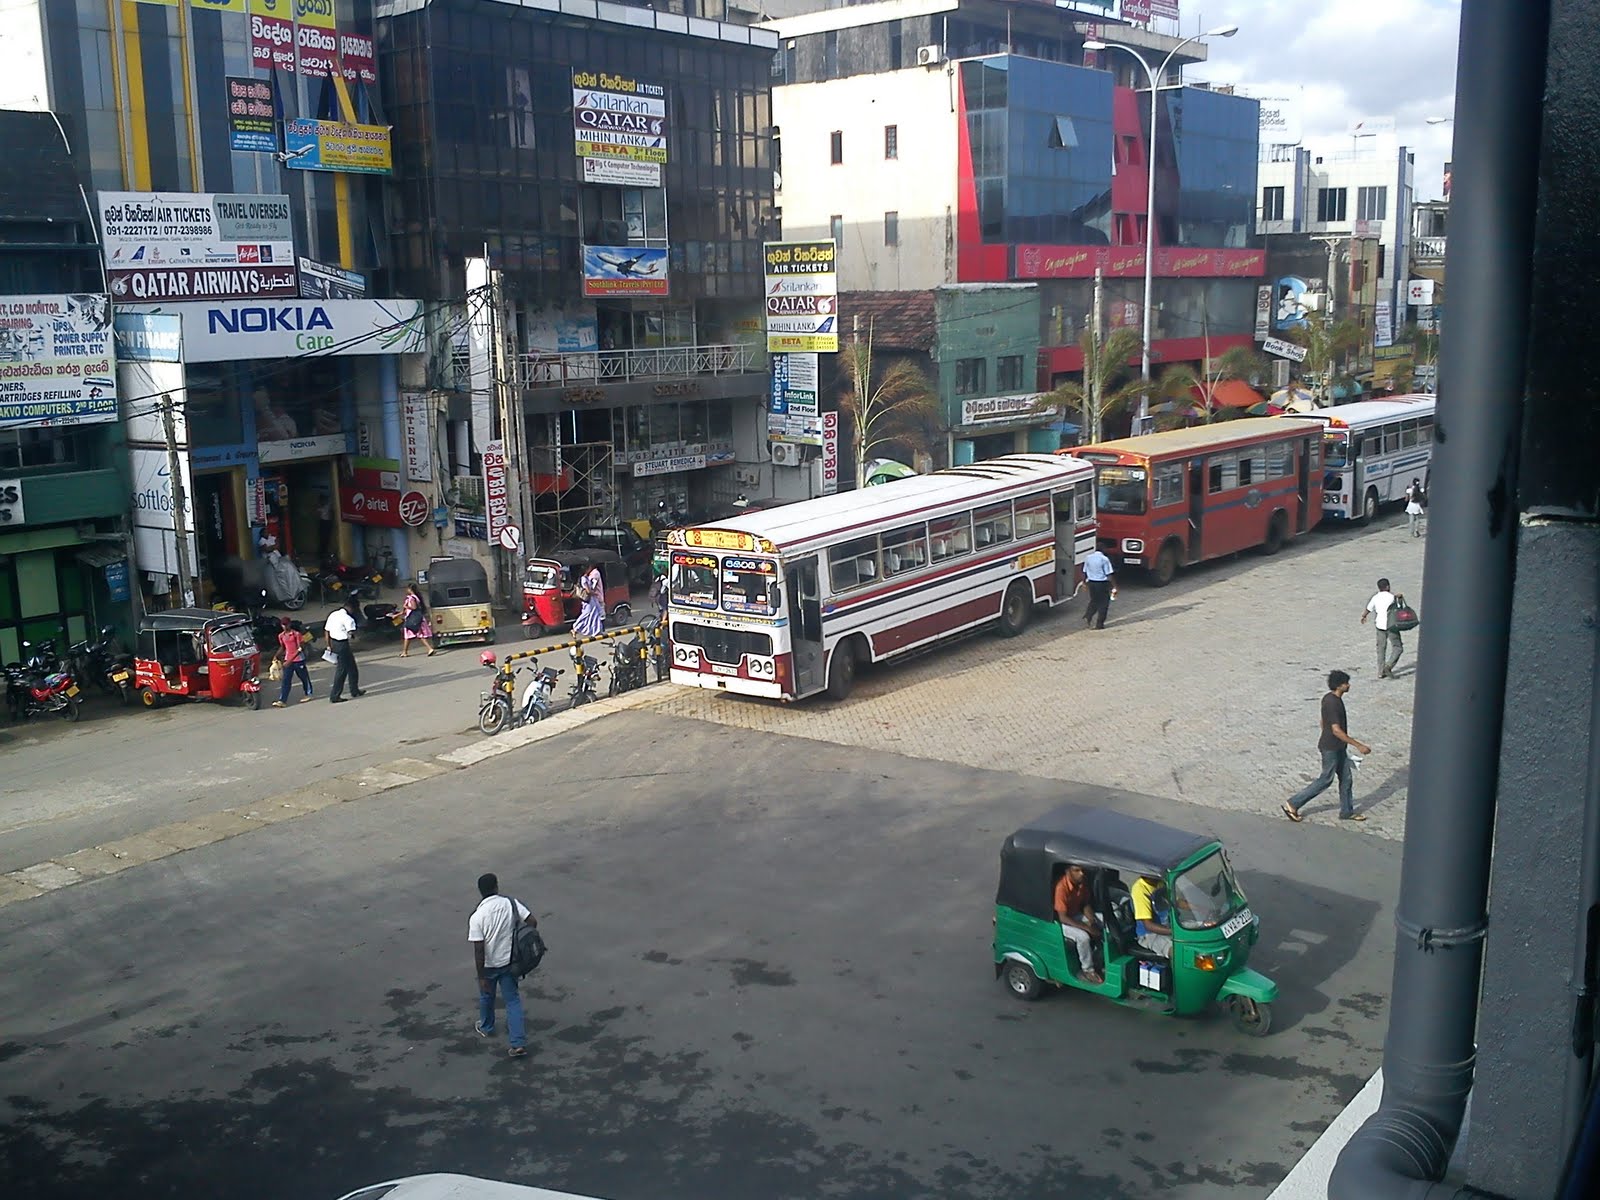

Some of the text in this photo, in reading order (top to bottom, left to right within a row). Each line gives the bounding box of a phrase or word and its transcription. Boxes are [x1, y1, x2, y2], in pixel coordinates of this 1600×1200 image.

[251, 16, 292, 46] විදේශ
[574, 72, 597, 88] ගුවන්
[636, 83, 664, 96] AIR TICKETS
[590, 92, 649, 114] SriLankan
[580, 110, 647, 129] QATAR
[580, 131, 648, 147] MIHIN LANKA
[591, 143, 629, 154] BETA
[173, 208, 211, 222] TICKETS
[217, 203, 288, 219] TRAVEL OVERSEAS
[106, 226, 158, 236] 091-2227172
[767, 249, 790, 266] ගුවන්
[773, 263, 829, 274] AIR TICKETS
[131, 270, 260, 299] QATAR AIRWAYS
[259, 273, 295, 291] القطرية
[619, 280, 640, 289] Travels
[0, 303, 60, 317] T, LCD MONITOR
[767, 296, 816, 314] QATAR
[207, 306, 334, 334] NOKIA
[770, 321, 816, 331] MIHIN LANKA
[53, 332, 109, 344] POWER SUPPLY
[136, 330, 180, 350] FINANCE
[295, 332, 335, 351] Care
[781, 337, 801, 345] BETA
[54, 344, 104, 357] PRINTER, ETC
[1265, 341, 1283, 352] Book
[1286, 347, 1305, 360] Shop
[0, 362, 53, 378] ළුත්වැඩියා
[773, 355, 782, 410] Internet
[43, 390, 82, 401] REFILLING
[784, 391, 815, 401] InforLink
[88, 399, 115, 411] FLOOR
[801, 405, 816, 413] Floor
[406, 396, 418, 477] INTERNET
[289, 440, 317, 449] NOKIA
[644, 457, 696, 470] STEUART REMEDICA
[132, 489, 192, 518] softlogc
[367, 498, 389, 512] airtel
